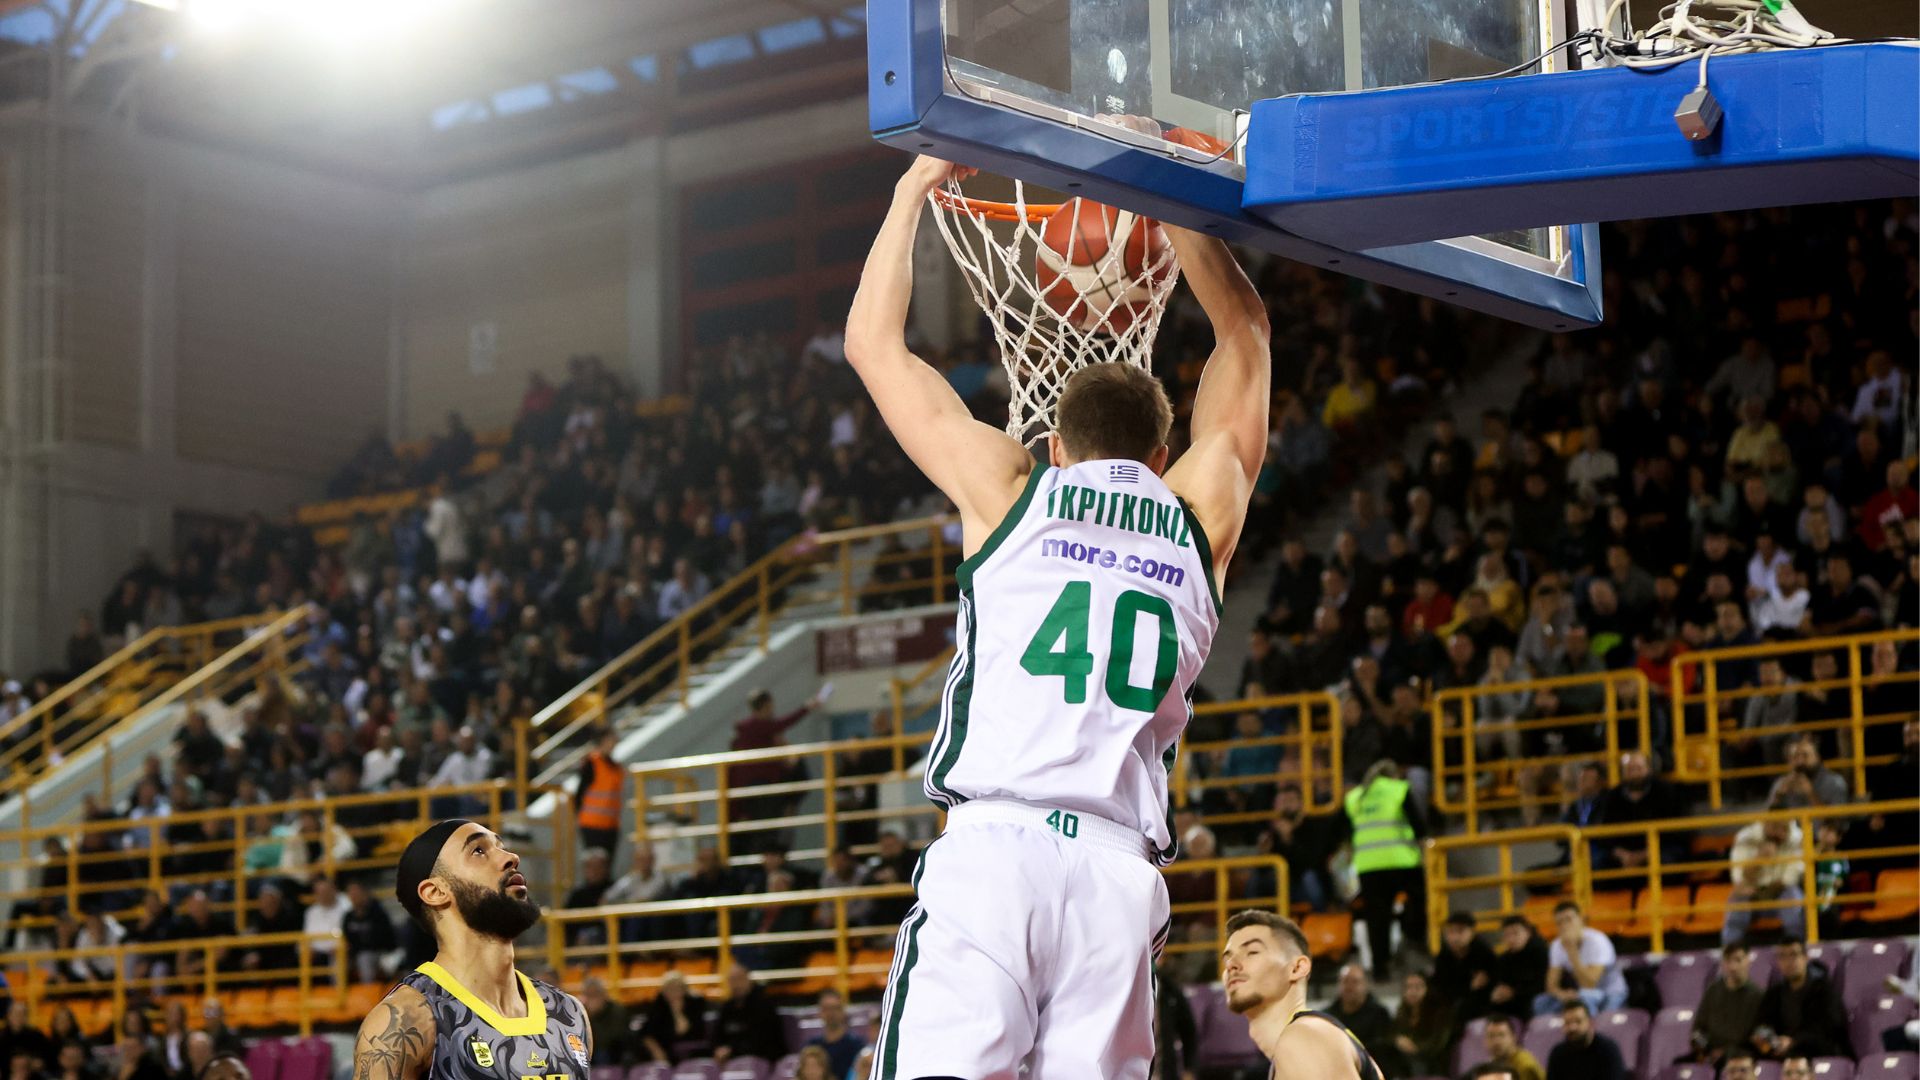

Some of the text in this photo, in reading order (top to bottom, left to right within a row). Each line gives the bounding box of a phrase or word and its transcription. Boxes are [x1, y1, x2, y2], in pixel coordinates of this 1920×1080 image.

[1041, 538, 1185, 587] more.com
[1020, 580, 1179, 713] 40
[1046, 810, 1079, 838] 40
